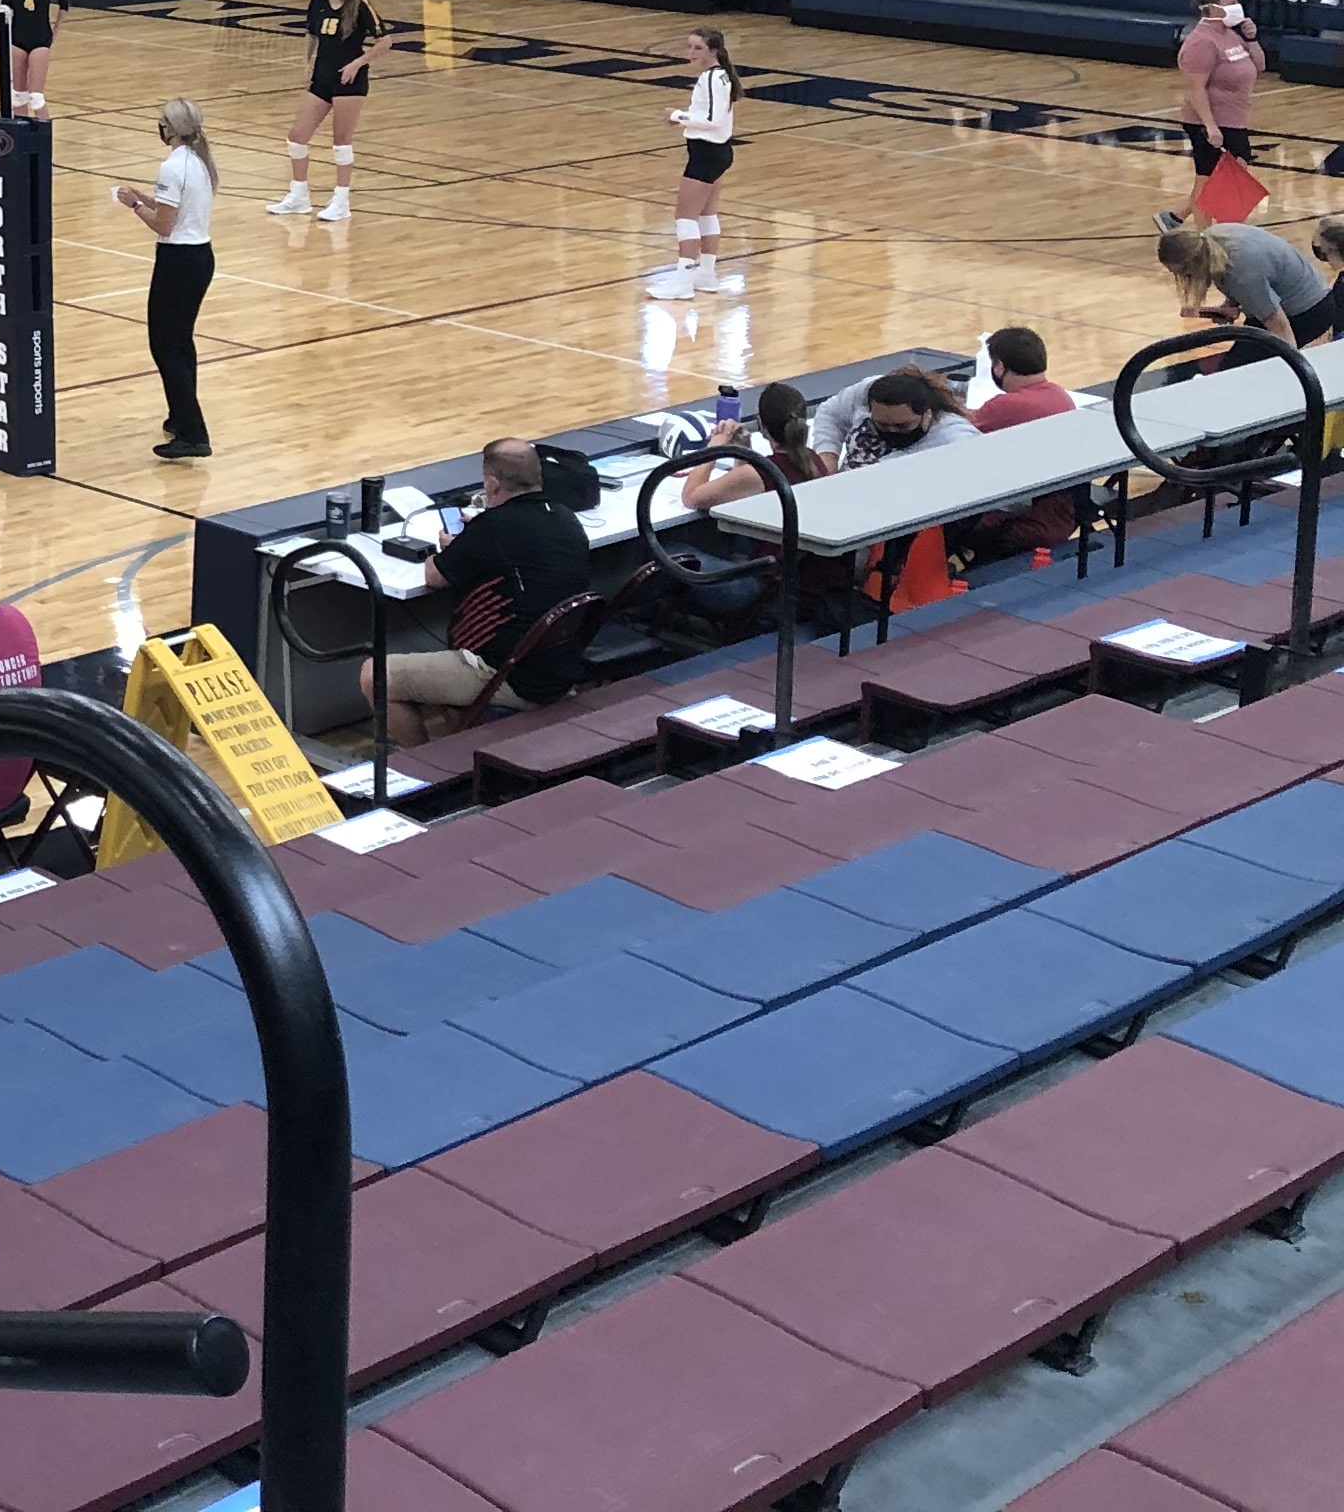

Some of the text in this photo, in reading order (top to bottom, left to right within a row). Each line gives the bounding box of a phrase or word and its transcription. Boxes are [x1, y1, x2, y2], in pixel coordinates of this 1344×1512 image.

[185, 669, 250, 705] PLEASE
[250, 759, 274, 774] STAY
[247, 770, 312, 796] THE GYM FLOOR
